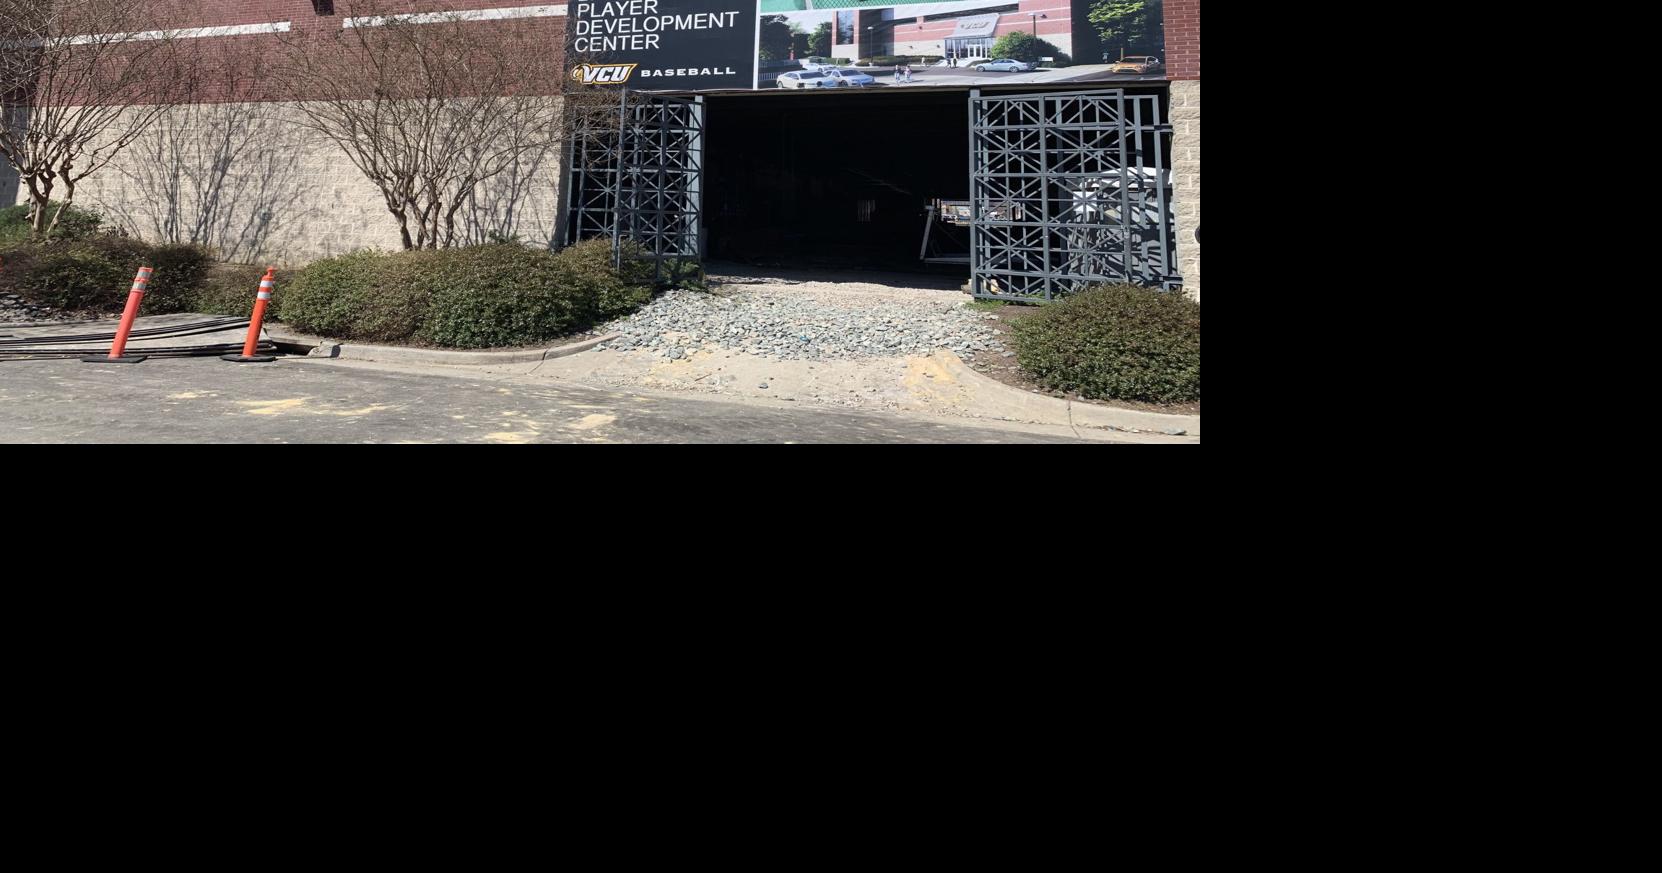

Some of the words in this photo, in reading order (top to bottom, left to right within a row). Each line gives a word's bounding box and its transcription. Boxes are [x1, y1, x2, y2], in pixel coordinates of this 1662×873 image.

[577, 0, 659, 18] PLAYER
[576, 11, 740, 36] DEVELOPMENT
[574, 33, 660, 53] CENTER
[573, 63, 638, 85] VCU
[640, 67, 737, 78] BASEBALL
